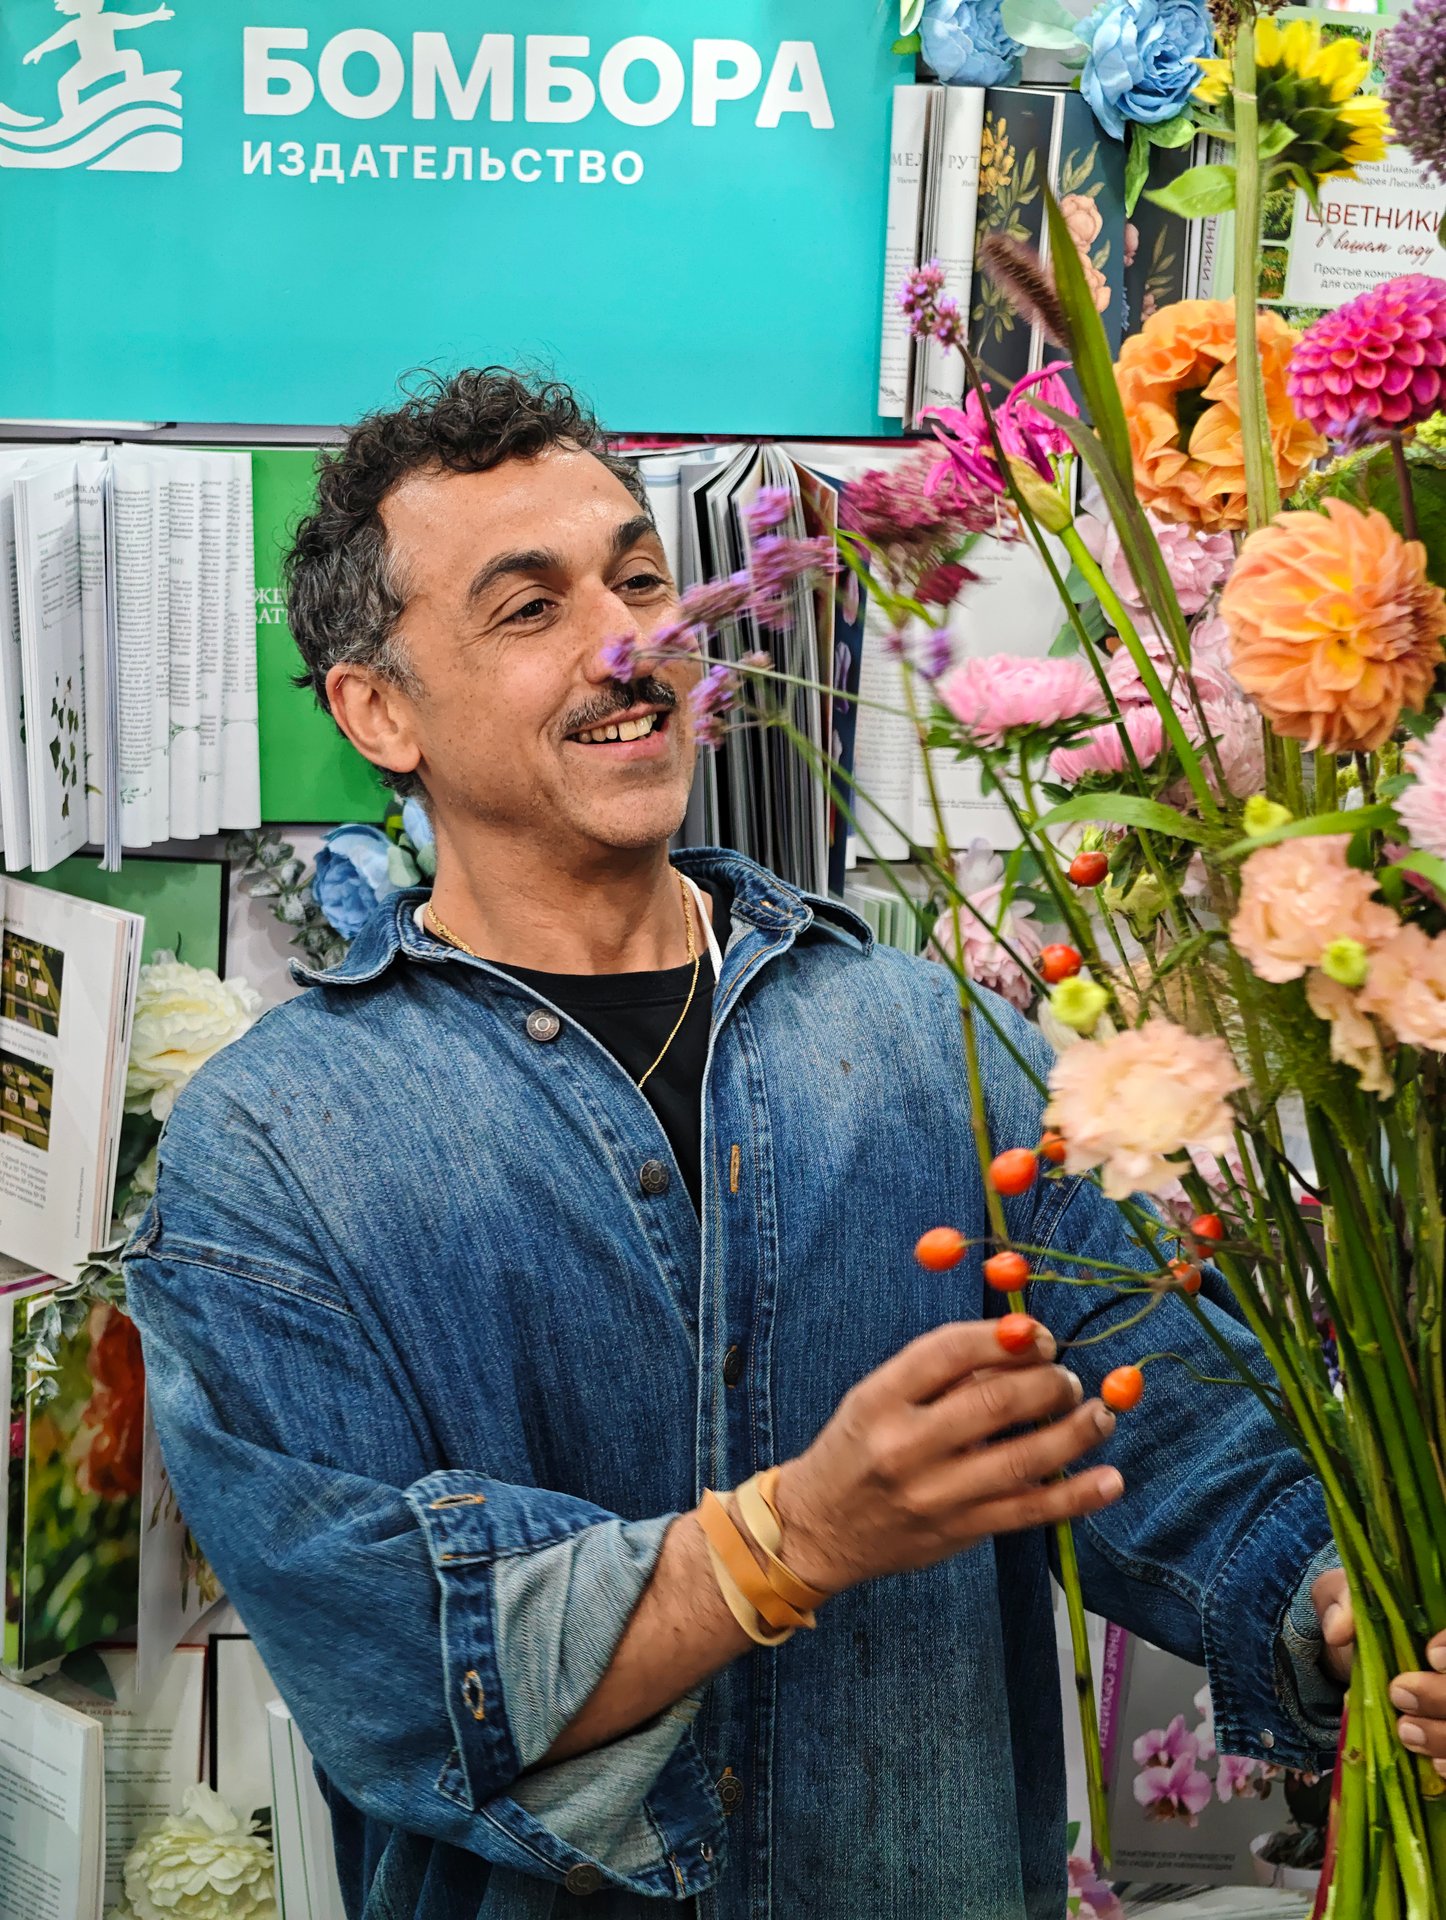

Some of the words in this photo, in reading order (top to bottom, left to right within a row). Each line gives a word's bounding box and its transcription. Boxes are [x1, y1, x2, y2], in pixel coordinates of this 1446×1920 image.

[243, 27, 835, 129] БОМБОРА
[242, 140, 644, 184] ИЗДАТЕЛЬСТВО
[1202, 214, 1218, 281] ТНИКИ
[1397, 244, 1436, 266] саду
[1313, 262, 1362, 277] Простые
[1320, 279, 1341, 289] для
